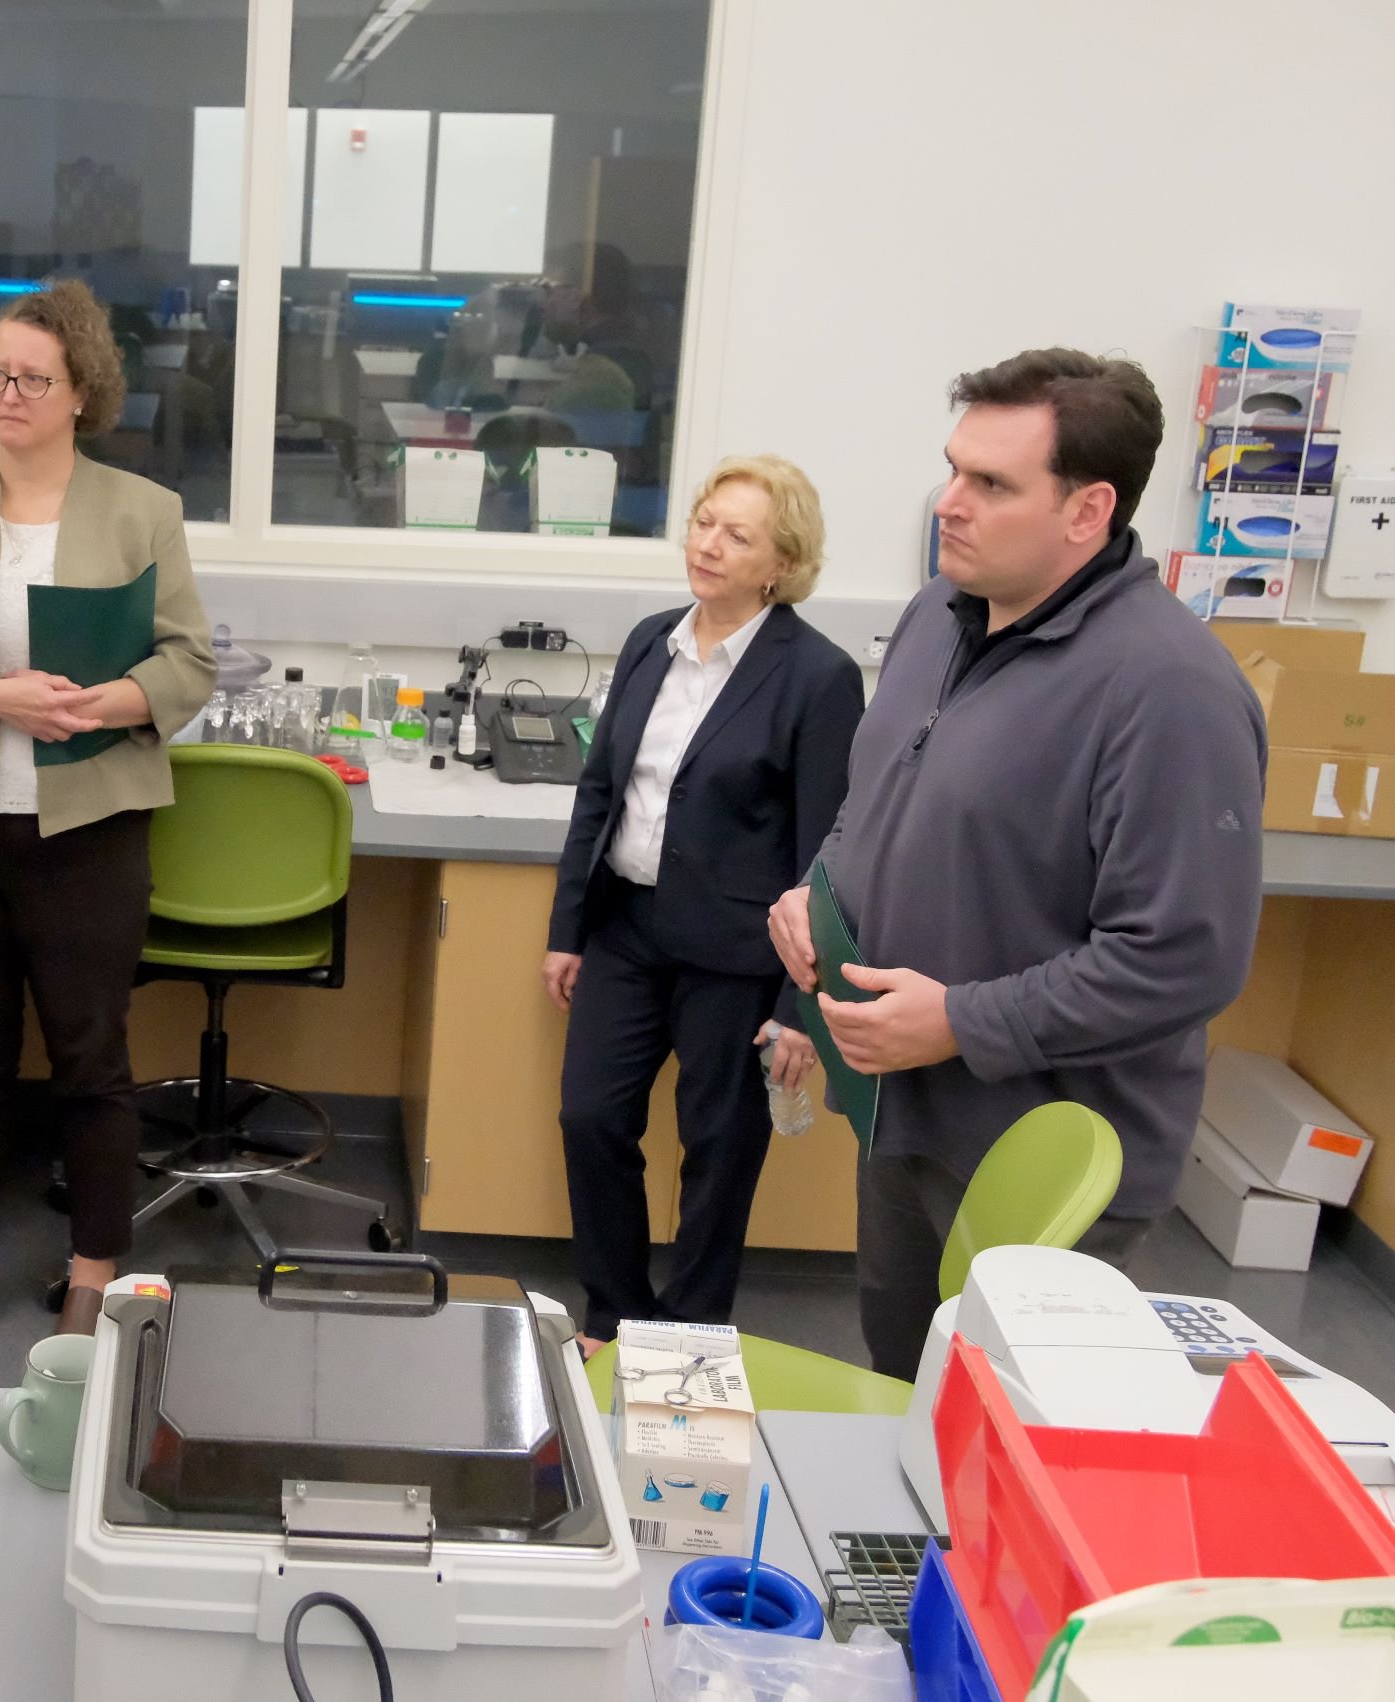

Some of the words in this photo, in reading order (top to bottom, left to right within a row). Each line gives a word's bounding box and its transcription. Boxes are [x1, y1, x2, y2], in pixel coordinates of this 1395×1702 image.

[1350, 495, 1377, 504] FIRST
[688, 1323, 734, 1335] PARAFILM
[725, 1375, 743, 1391] FILM
[637, 1421, 667, 1430] PARAFILM
[670, 1414, 687, 1431] M
